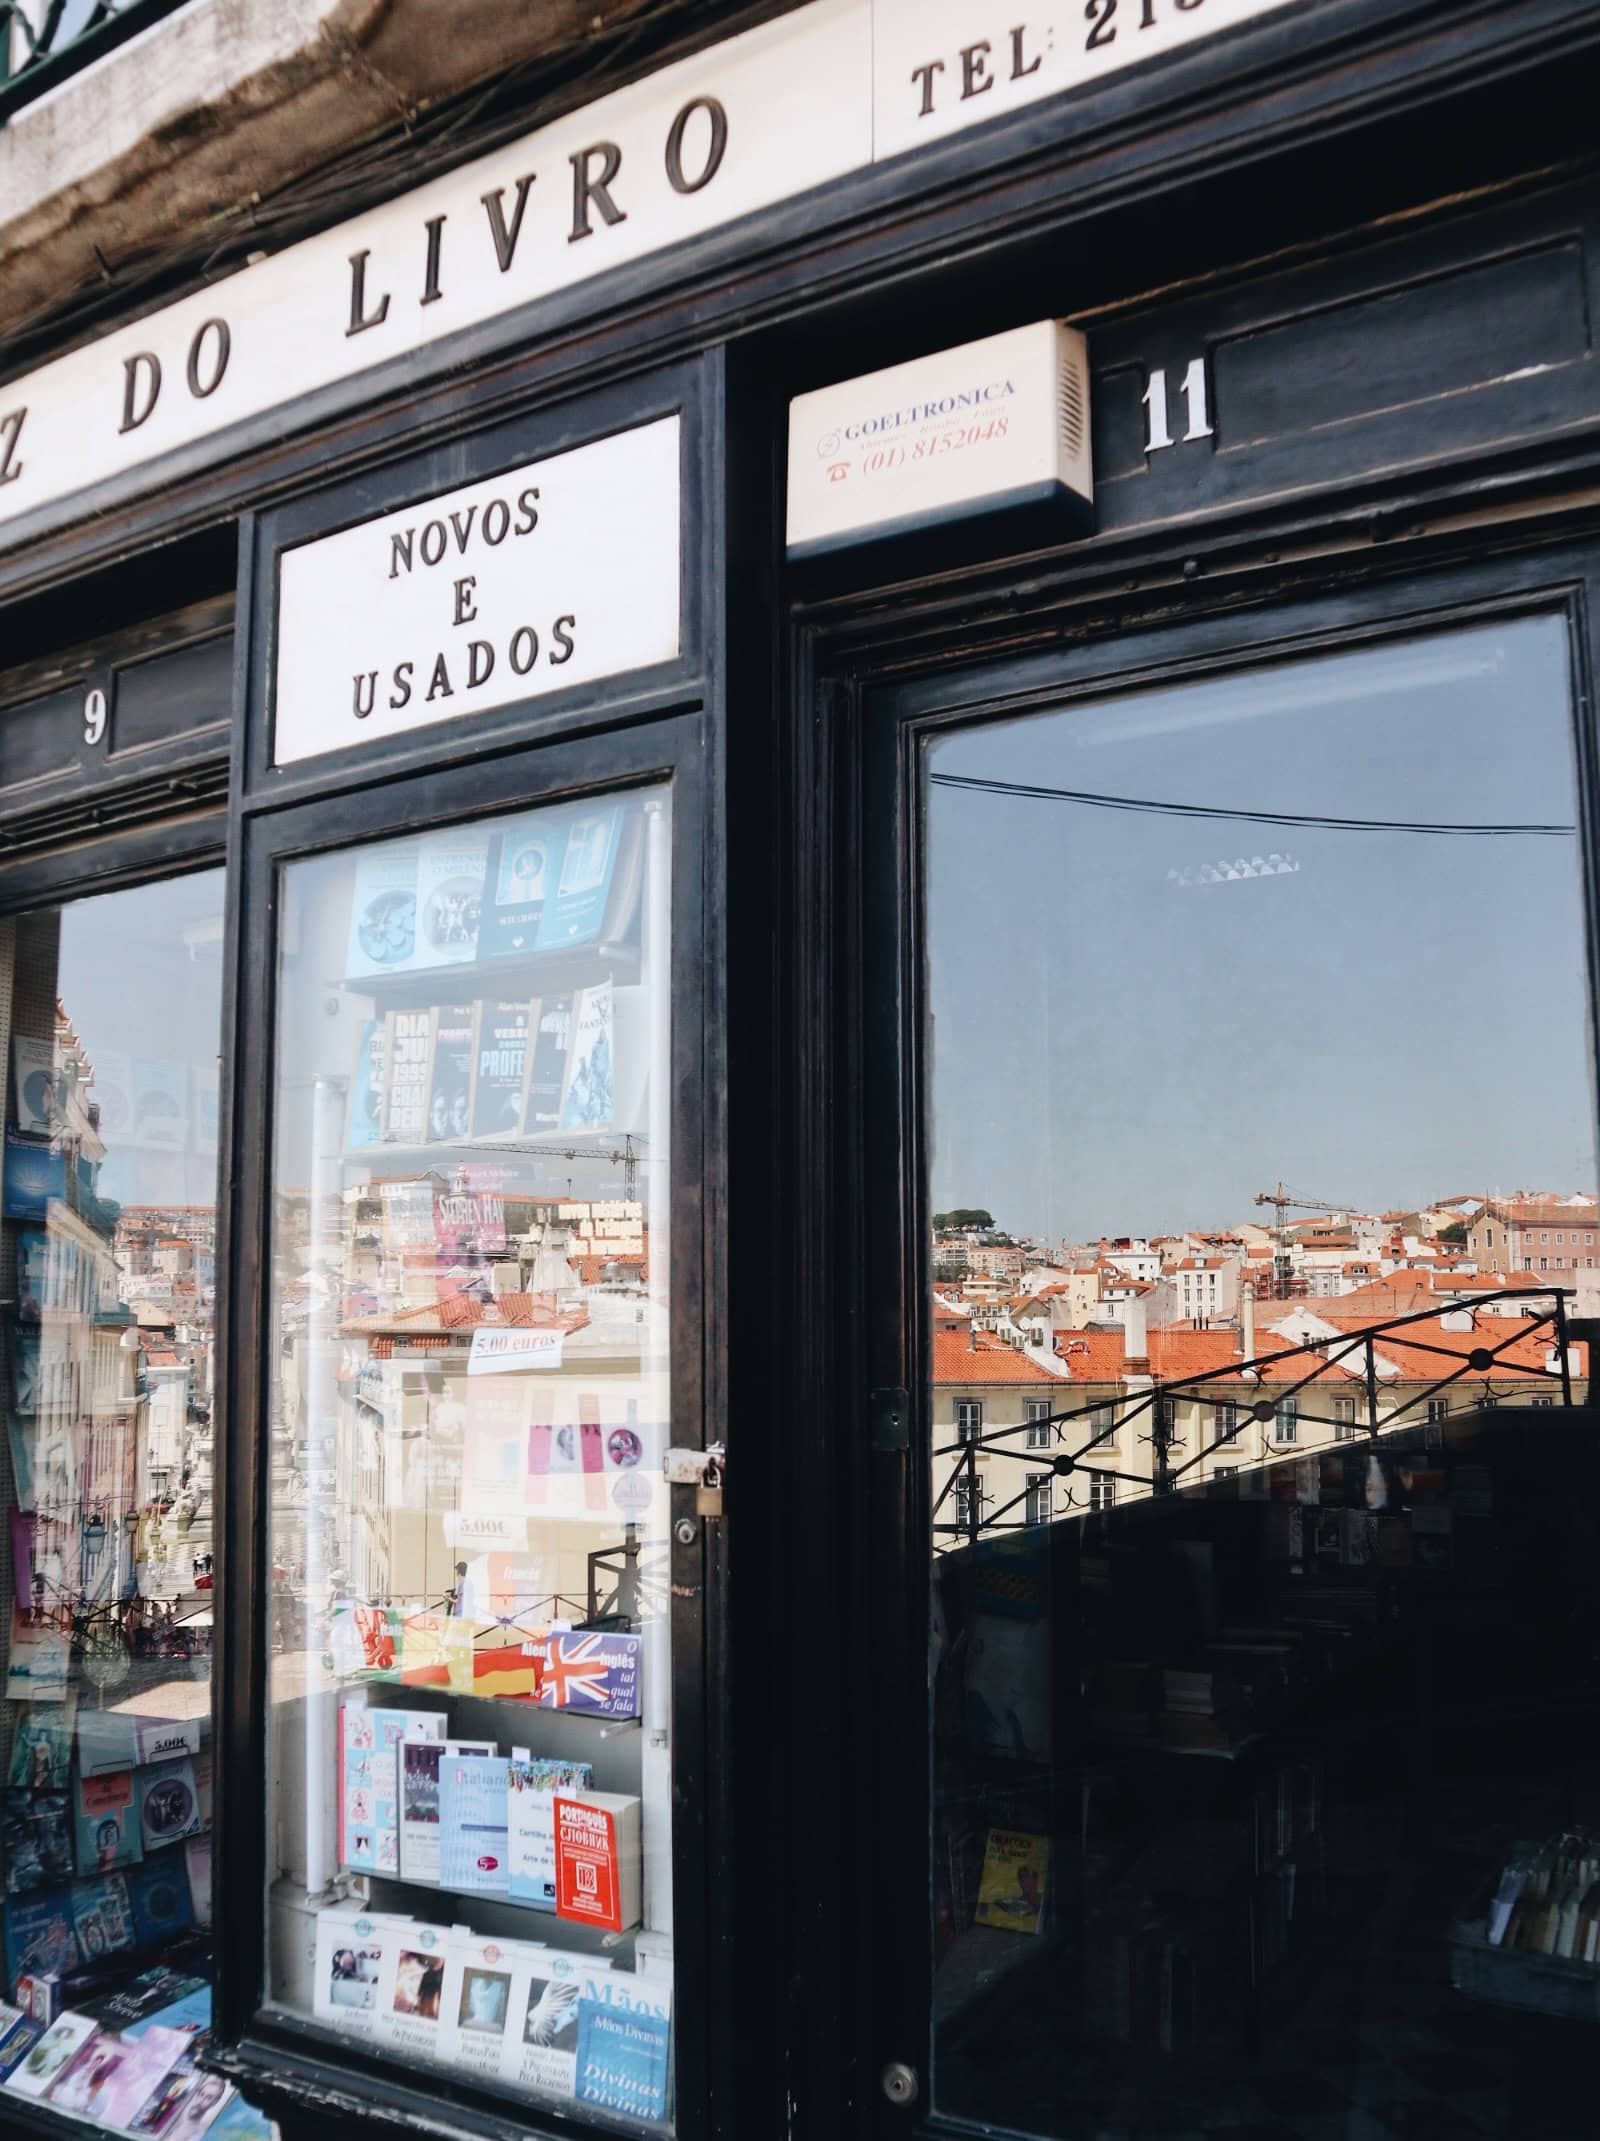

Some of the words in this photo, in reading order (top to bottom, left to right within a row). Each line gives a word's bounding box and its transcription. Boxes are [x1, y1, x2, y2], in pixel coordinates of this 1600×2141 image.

[118, 317, 233, 434] DO
[345, 95, 730, 338] LIVRO
[845, 379, 1015, 440] GOELTRONICA
[1141, 357, 1217, 454] 11
[863, 448, 905, 476] (01)
[912, 417, 1009, 460] 8152048
[388, 489, 541, 578] NOVOS
[453, 577, 478, 626] E
[353, 615, 577, 719] USADOS
[83, 689, 107, 745] 9
[475, 1336, 508, 1354] 5.00
[512, 1335, 556, 1350] euros
[600, 1652, 636, 1669] Inglês
[627, 1640, 638, 1654] O
[610, 1685, 635, 1699] qual
[620, 1671, 635, 1684] tal
[611, 1699, 634, 1713] fala
[595, 2015, 624, 2034] Mãos
[583, 2063, 661, 2098] Divinas
[583, 2085, 660, 2121] Divinas
